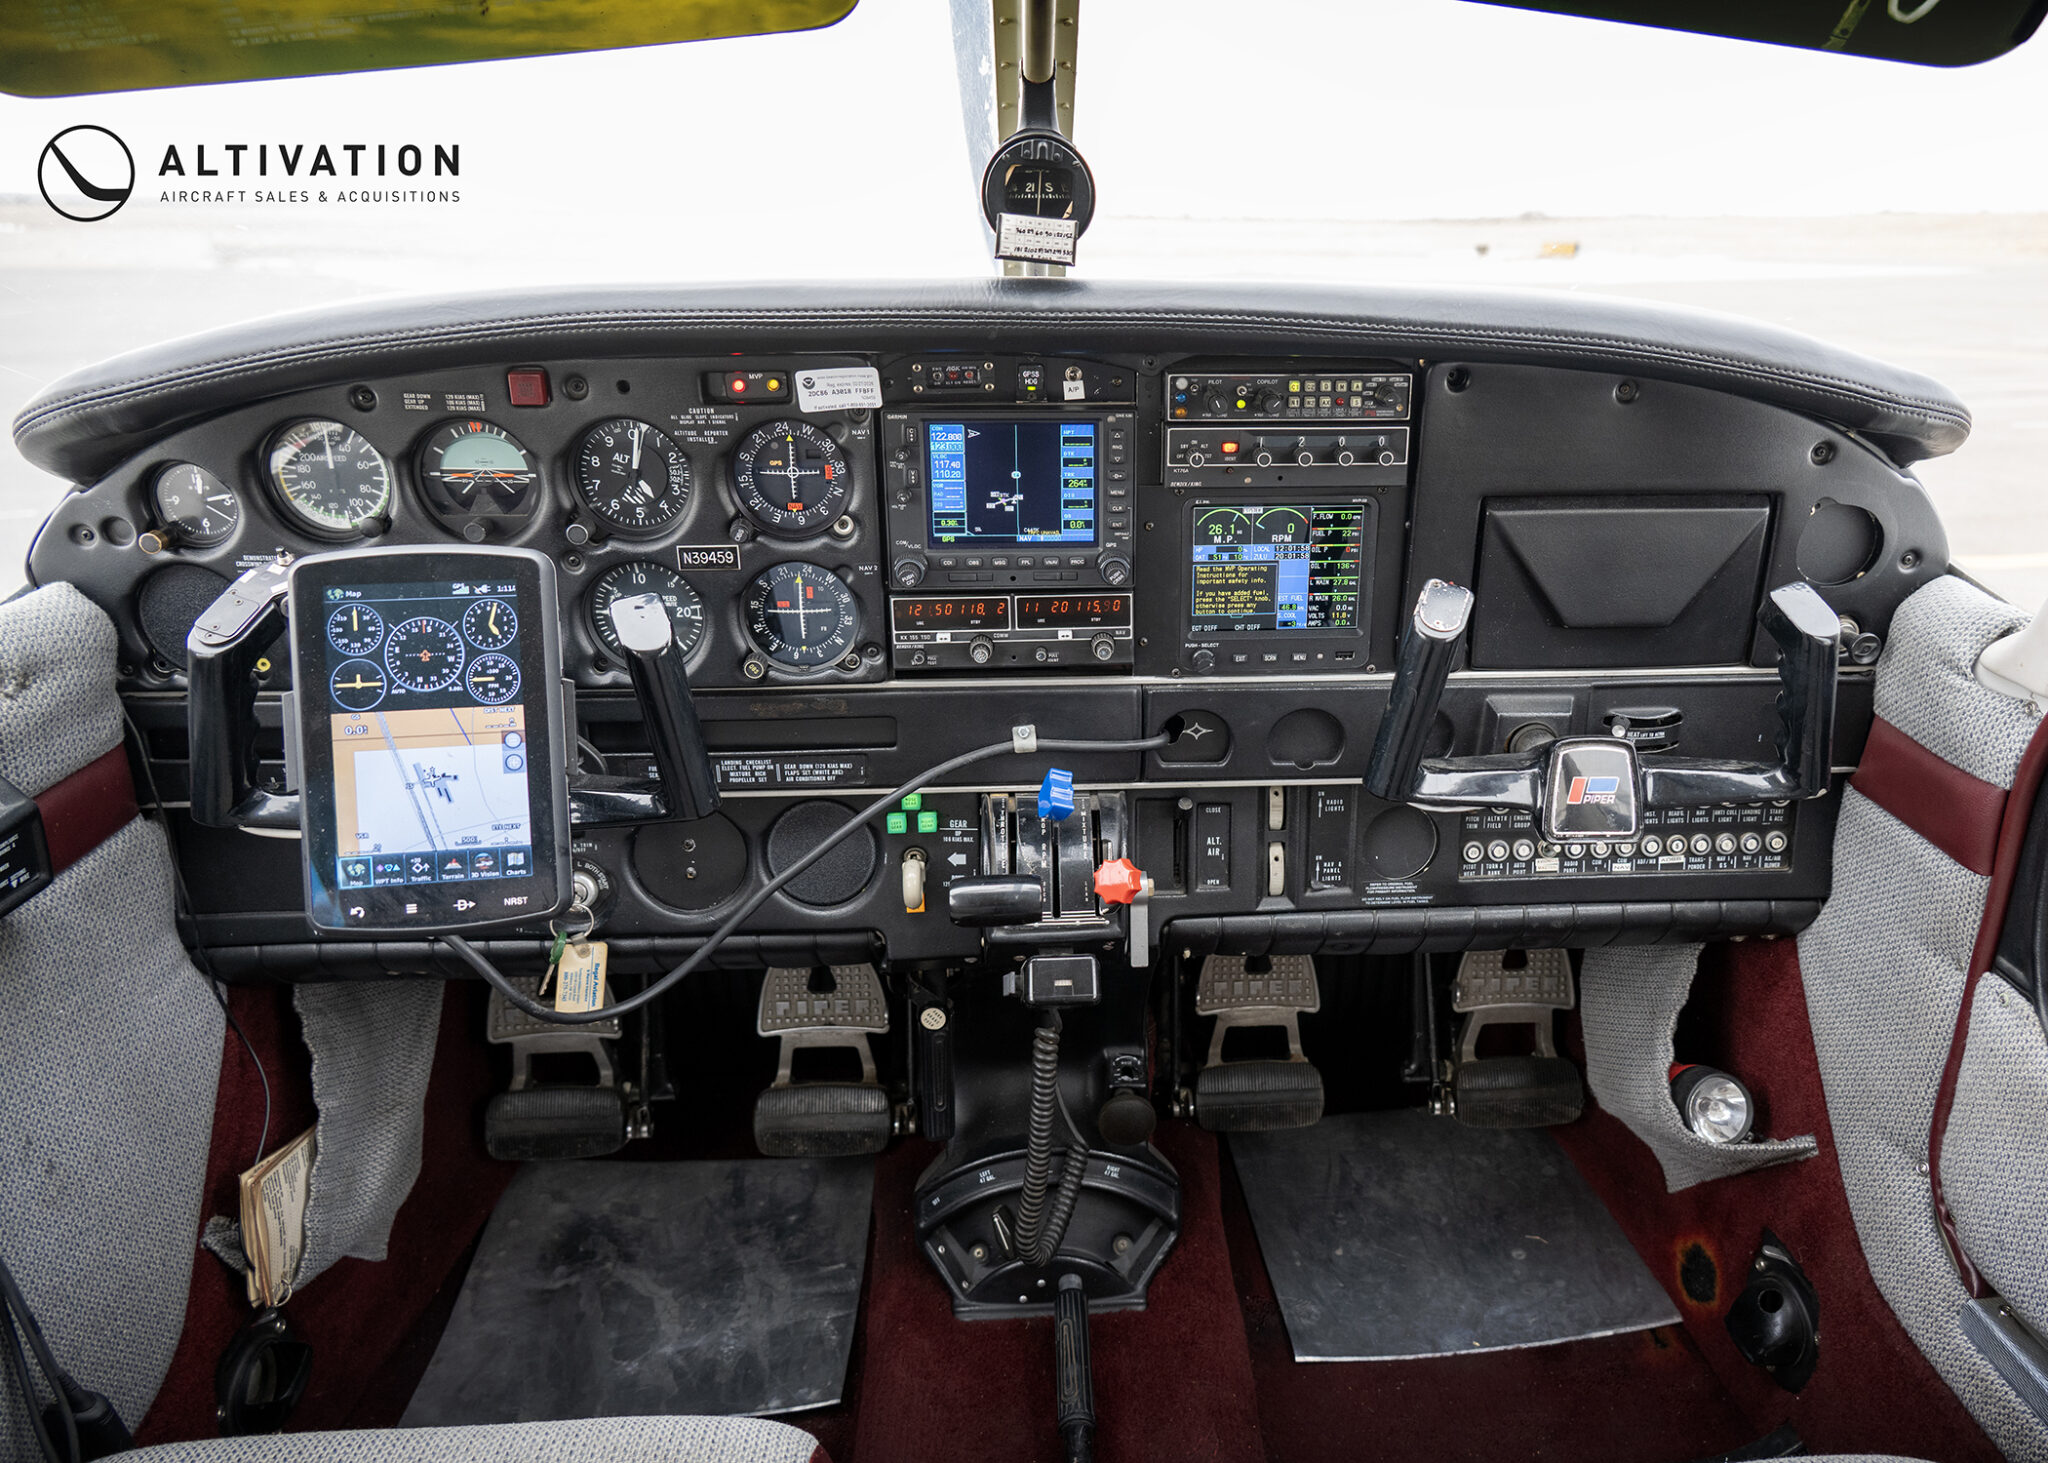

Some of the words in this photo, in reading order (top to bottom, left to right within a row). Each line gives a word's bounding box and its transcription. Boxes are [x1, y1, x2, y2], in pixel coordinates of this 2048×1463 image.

[1026, 182, 1035, 192] 21
[775, 422, 789, 432] 24
[752, 430, 765, 443] 21
[613, 452, 630, 463] ALT
[298, 465, 311, 473] 180
[357, 461, 369, 470] 60
[301, 481, 316, 489] 160
[683, 551, 734, 565] N39459
[633, 573, 646, 584] 10
[345, 590, 362, 598] Map
[677, 607, 691, 617] 20
[1583, 795, 1616, 804] PIPER
[1207, 837, 1222, 845] ALT.
[1208, 848, 1220, 856] AIR
[504, 897, 528, 906] NRST
[776, 1000, 870, 1016] PIPER
[979, 1169, 991, 1178] LEFT
